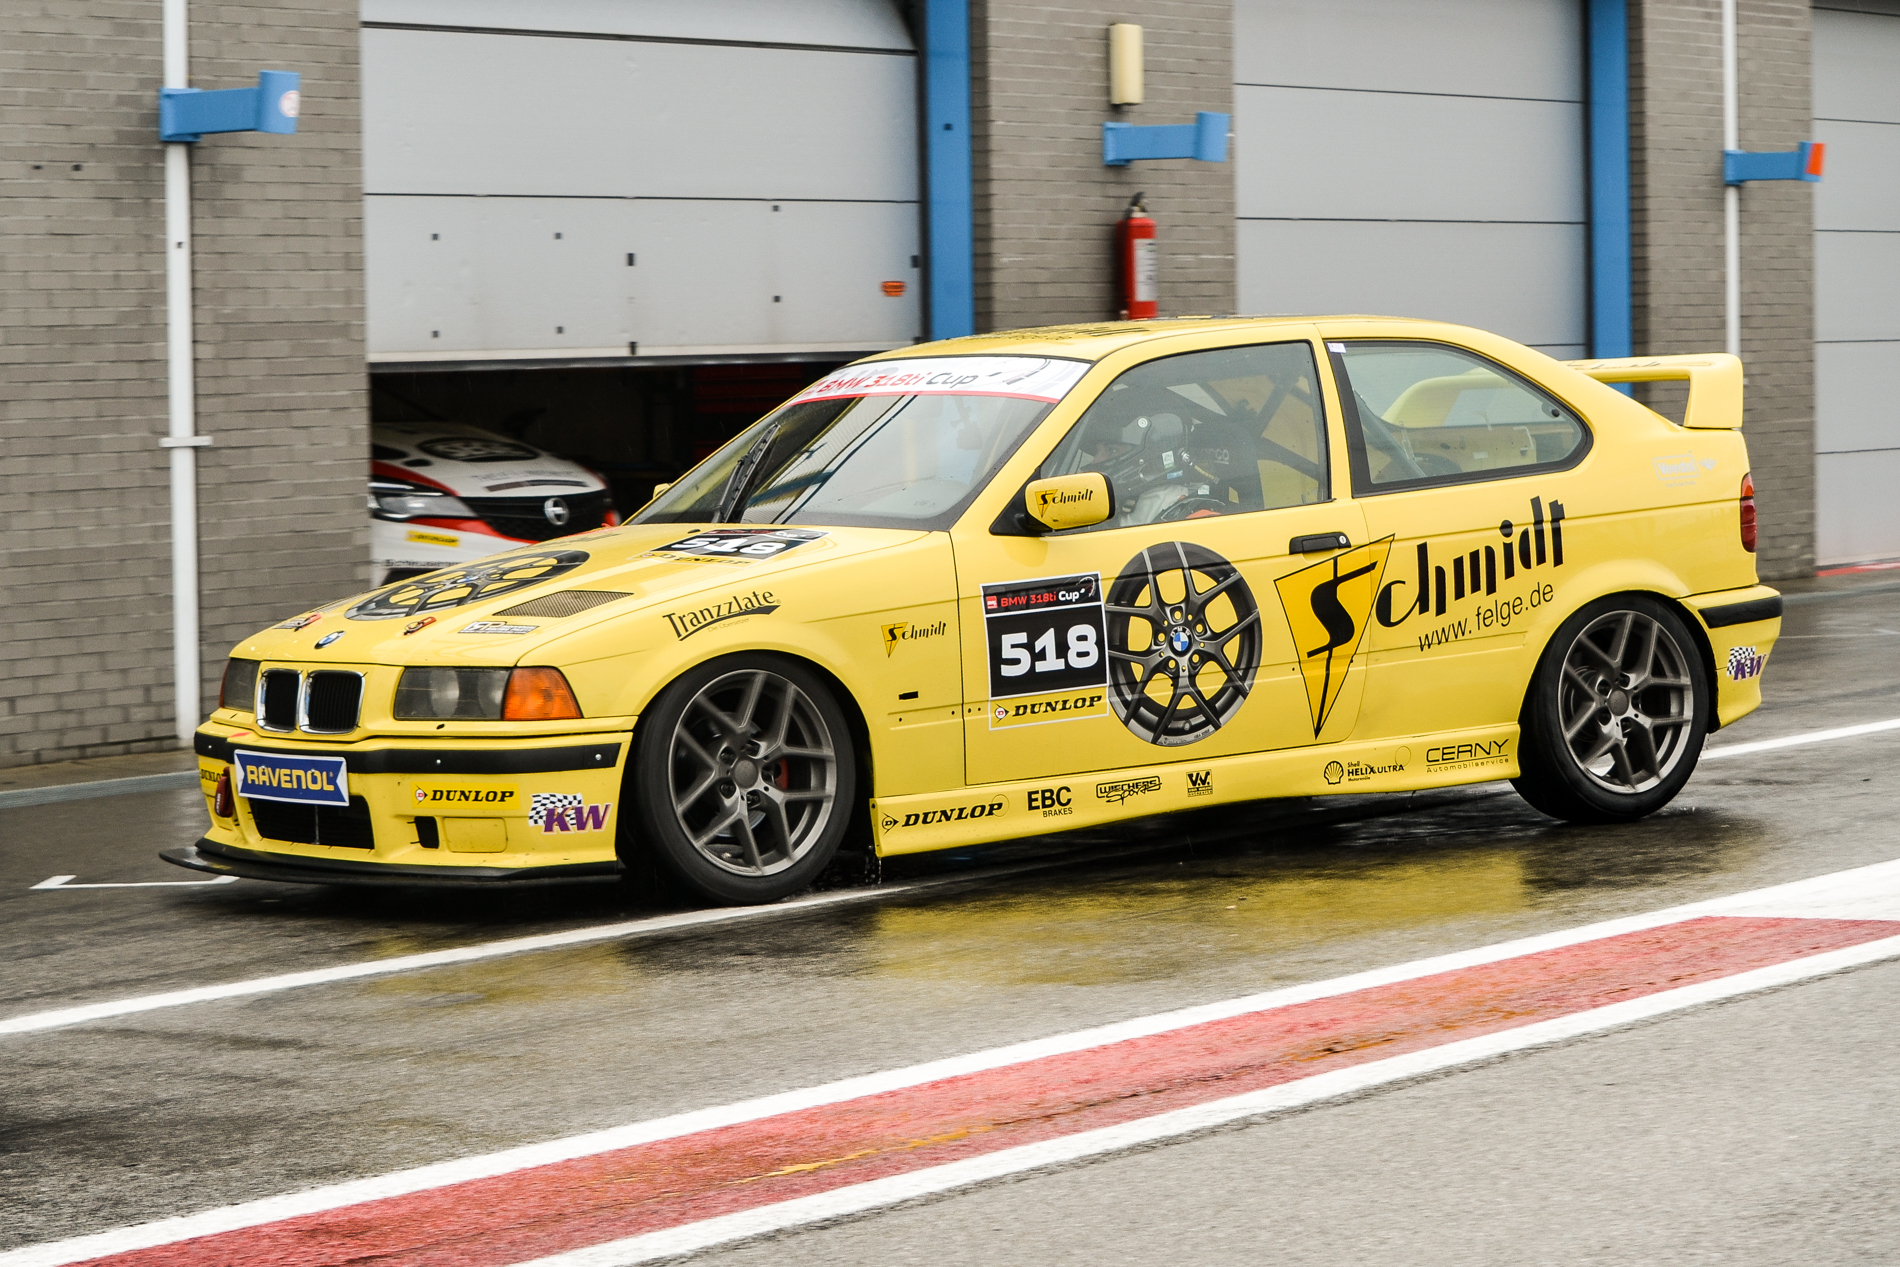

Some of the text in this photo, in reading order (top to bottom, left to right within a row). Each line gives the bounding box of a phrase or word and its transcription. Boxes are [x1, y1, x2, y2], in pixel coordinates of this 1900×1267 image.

[926, 373, 979, 388] Cup
[1039, 488, 1094, 518] Schmidt
[671, 537, 787, 554] 518
[1000, 595, 1028, 608] BMW
[1030, 591, 1057, 604] 318ti
[1058, 590, 1080, 602] Cup
[662, 590, 777, 639] Tranzzlate
[1307, 495, 1566, 738] Schmidt
[887, 620, 946, 658] Schmidt
[1001, 624, 1099, 677] 518
[1733, 654, 1767, 681] KW
[1012, 695, 1103, 717] DUNLOP
[1427, 738, 1509, 763] CERNY
[246, 765, 335, 791] RAVENOL
[1347, 764, 1404, 776] HELIX ULTRA
[1427, 757, 1509, 774] Automobilservice
[430, 789, 514, 802] DUNLOP
[1027, 786, 1072, 811] EBC
[543, 803, 612, 834] KW
[902, 802, 1003, 828] DUNLOP
[1042, 807, 1073, 818] BRAKES
